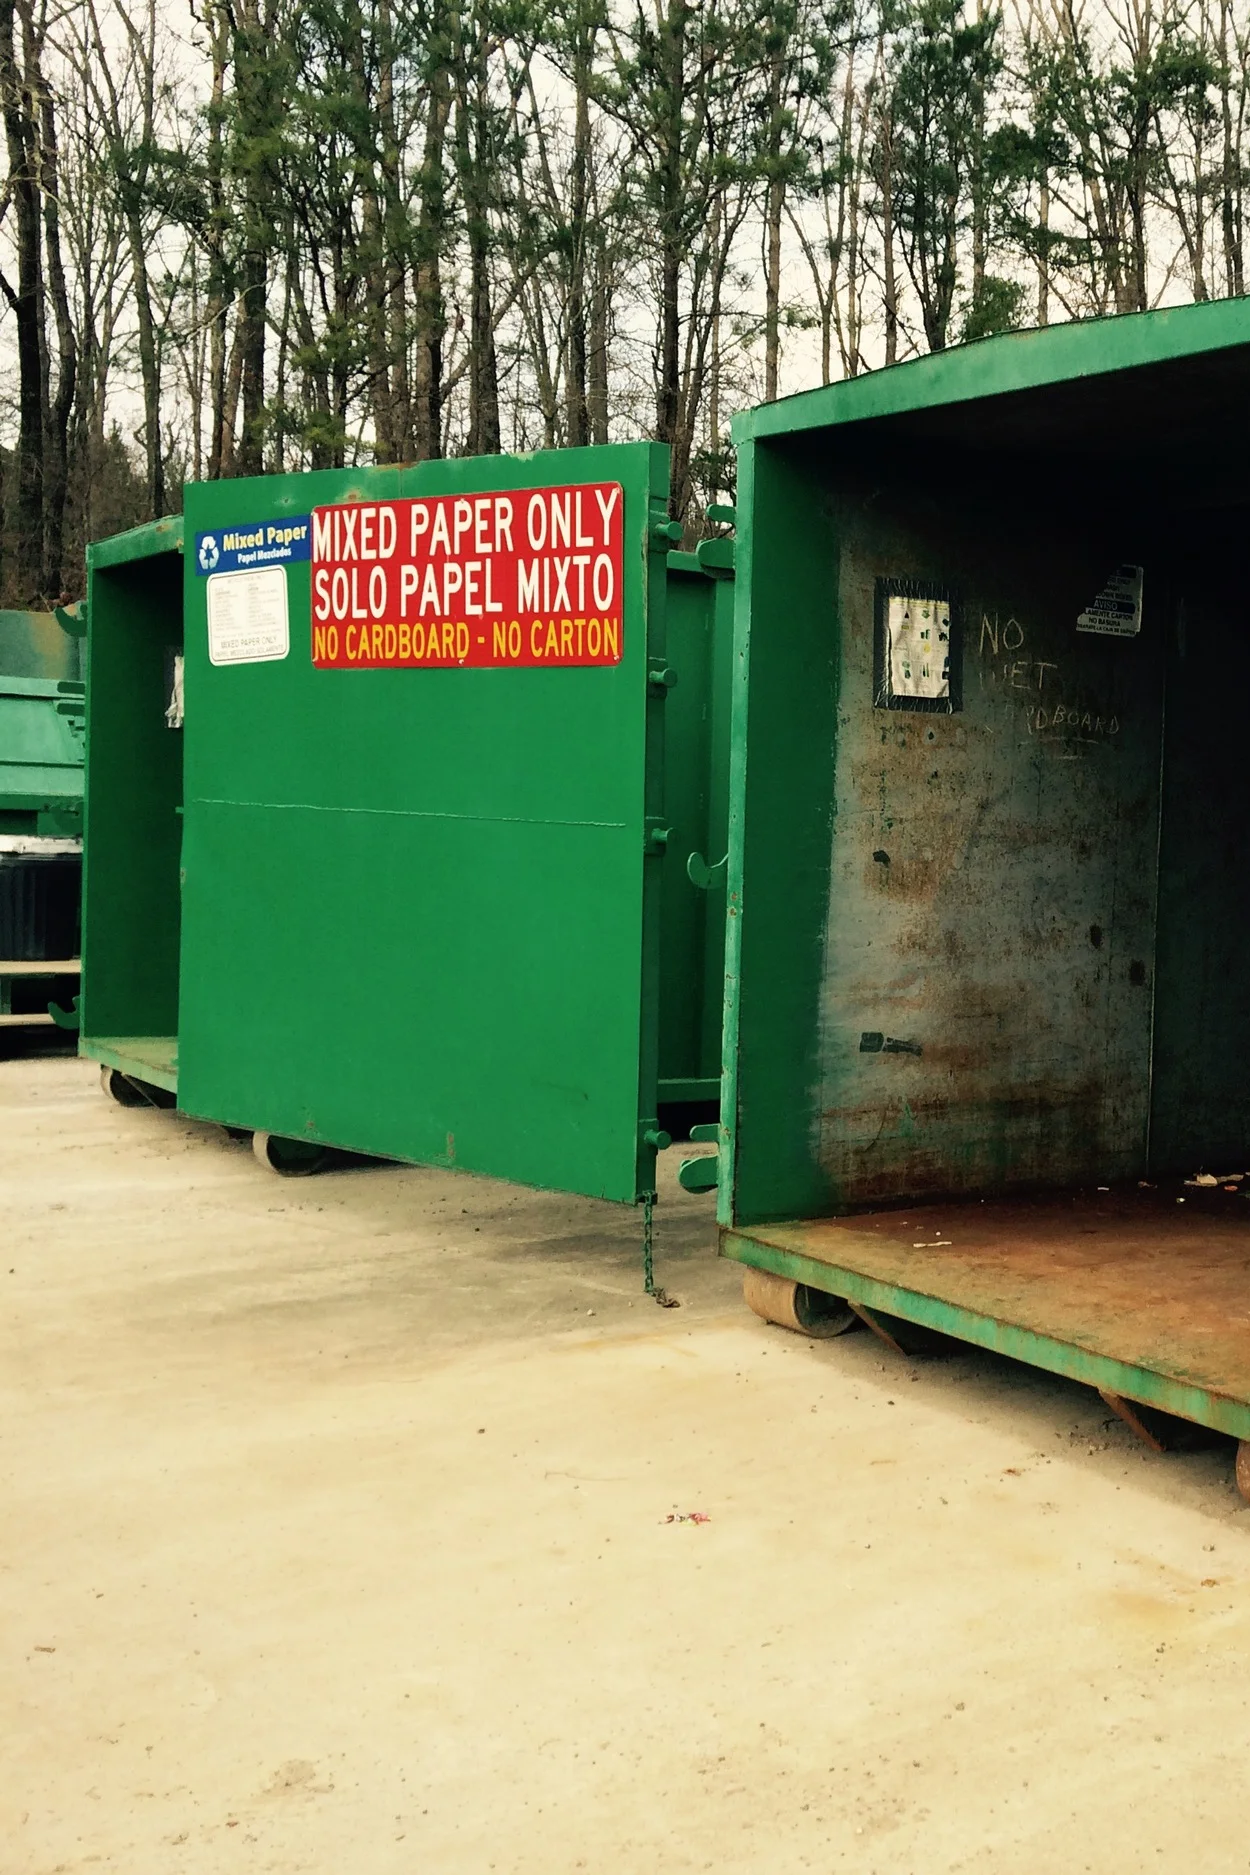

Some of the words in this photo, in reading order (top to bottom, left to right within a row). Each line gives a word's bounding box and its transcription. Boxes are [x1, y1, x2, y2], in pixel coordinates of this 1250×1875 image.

[223, 528, 264, 552] Mixed
[267, 525, 307, 546] Paper
[313, 505, 397, 563] MIXED
[409, 496, 513, 558] PAPER
[526, 488, 620, 552] ONLY
[237, 551, 256, 565] Papel
[313, 565, 388, 621] SOLO
[400, 558, 503, 618] PAPEL
[517, 553, 615, 615] MIXTO
[1093, 599, 1118, 611] AVISO
[313, 625, 338, 661] NO
[345, 620, 470, 660] CARDBOARD
[492, 620, 521, 658] NO
[523, 617, 619, 658] CARTON
[979, 611, 1025, 657] NO
[985, 703, 1121, 736] RDBOARD
